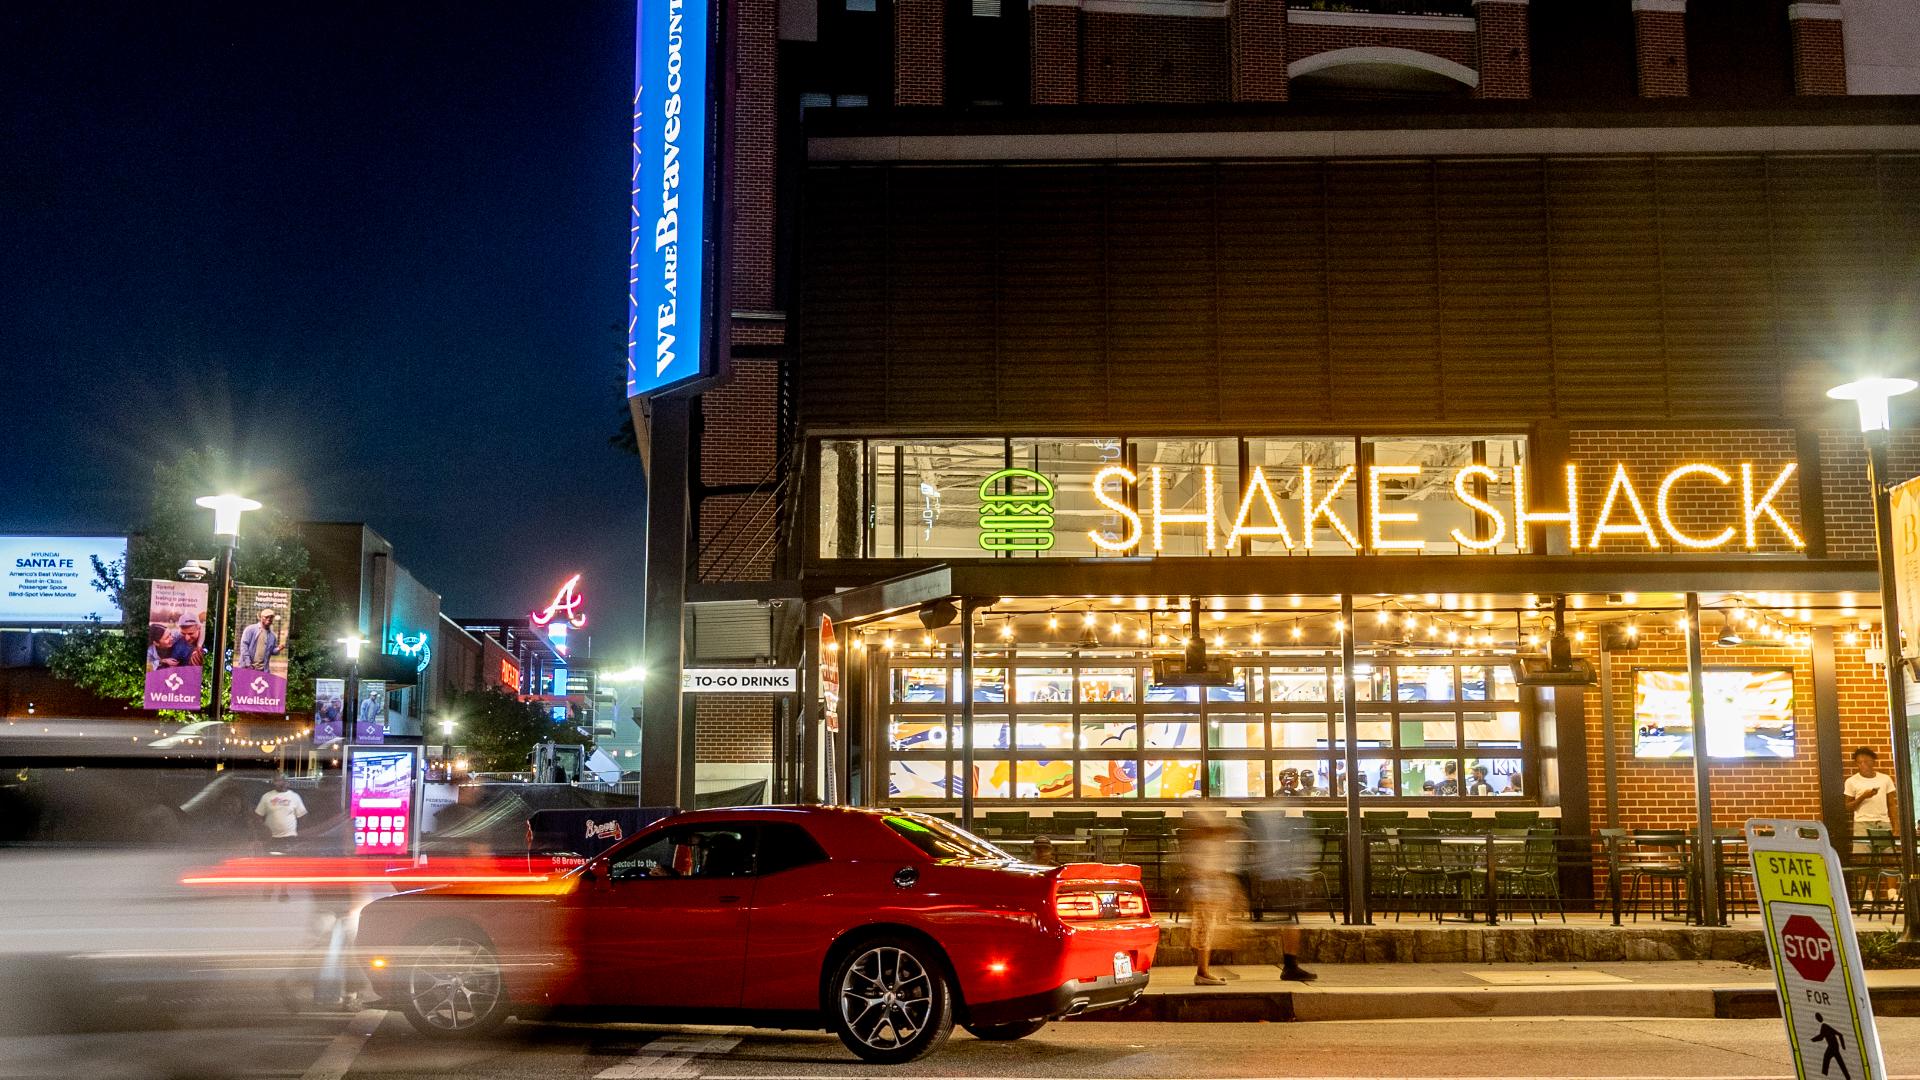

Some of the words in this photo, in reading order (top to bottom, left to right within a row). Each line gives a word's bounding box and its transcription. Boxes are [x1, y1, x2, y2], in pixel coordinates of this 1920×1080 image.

[655, 94, 681, 252] Braves
[665, 246, 677, 297] ARE
[656, 296, 676, 377] WE
[1089, 463, 1425, 554] SHAKE
[1450, 460, 1806, 552] SHACK
[16, 559, 56, 568] SANTA
[60, 559, 74, 568] FE
[532, 574, 586, 627] A
[695, 676, 738, 686] TO-GO
[742, 676, 789, 686] DRINKS
[150, 692, 196, 703] Wellstar
[236, 695, 280, 706] Wellstar
[552, 856, 561, 865] 58
[561, 856, 585, 865] Braves
[645, 859, 657, 868] the
[1769, 857, 1816, 877] STATE
[1780, 879, 1812, 898] LAW
[1783, 934, 1832, 961] STOP
[1805, 989, 1831, 1006] FOR
